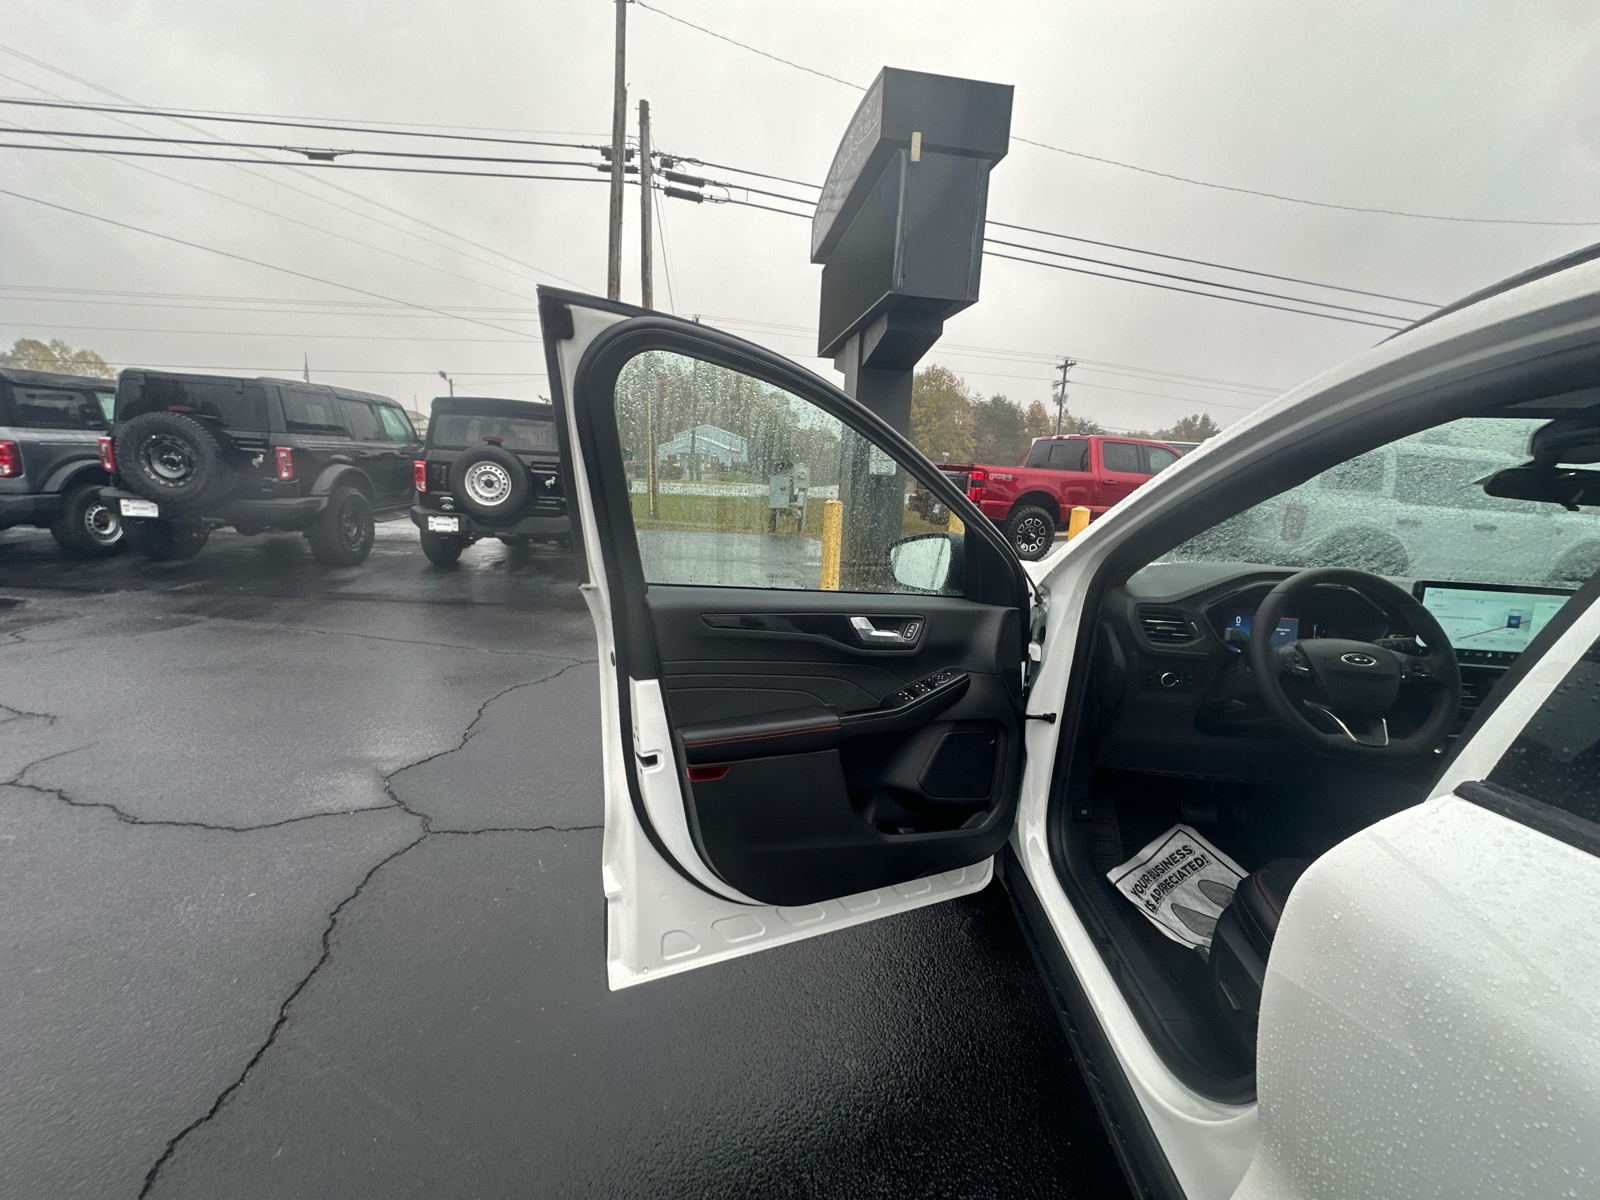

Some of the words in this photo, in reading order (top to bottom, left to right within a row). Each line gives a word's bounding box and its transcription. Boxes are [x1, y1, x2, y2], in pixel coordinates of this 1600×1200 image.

[1235, 615, 1242, 624] 0
[1131, 873, 1152, 900] YOUR
[1147, 845, 1195, 880] BUSINESS
[1150, 854, 1211, 905] APPRECIATED!
[1144, 900, 1158, 915] IS
